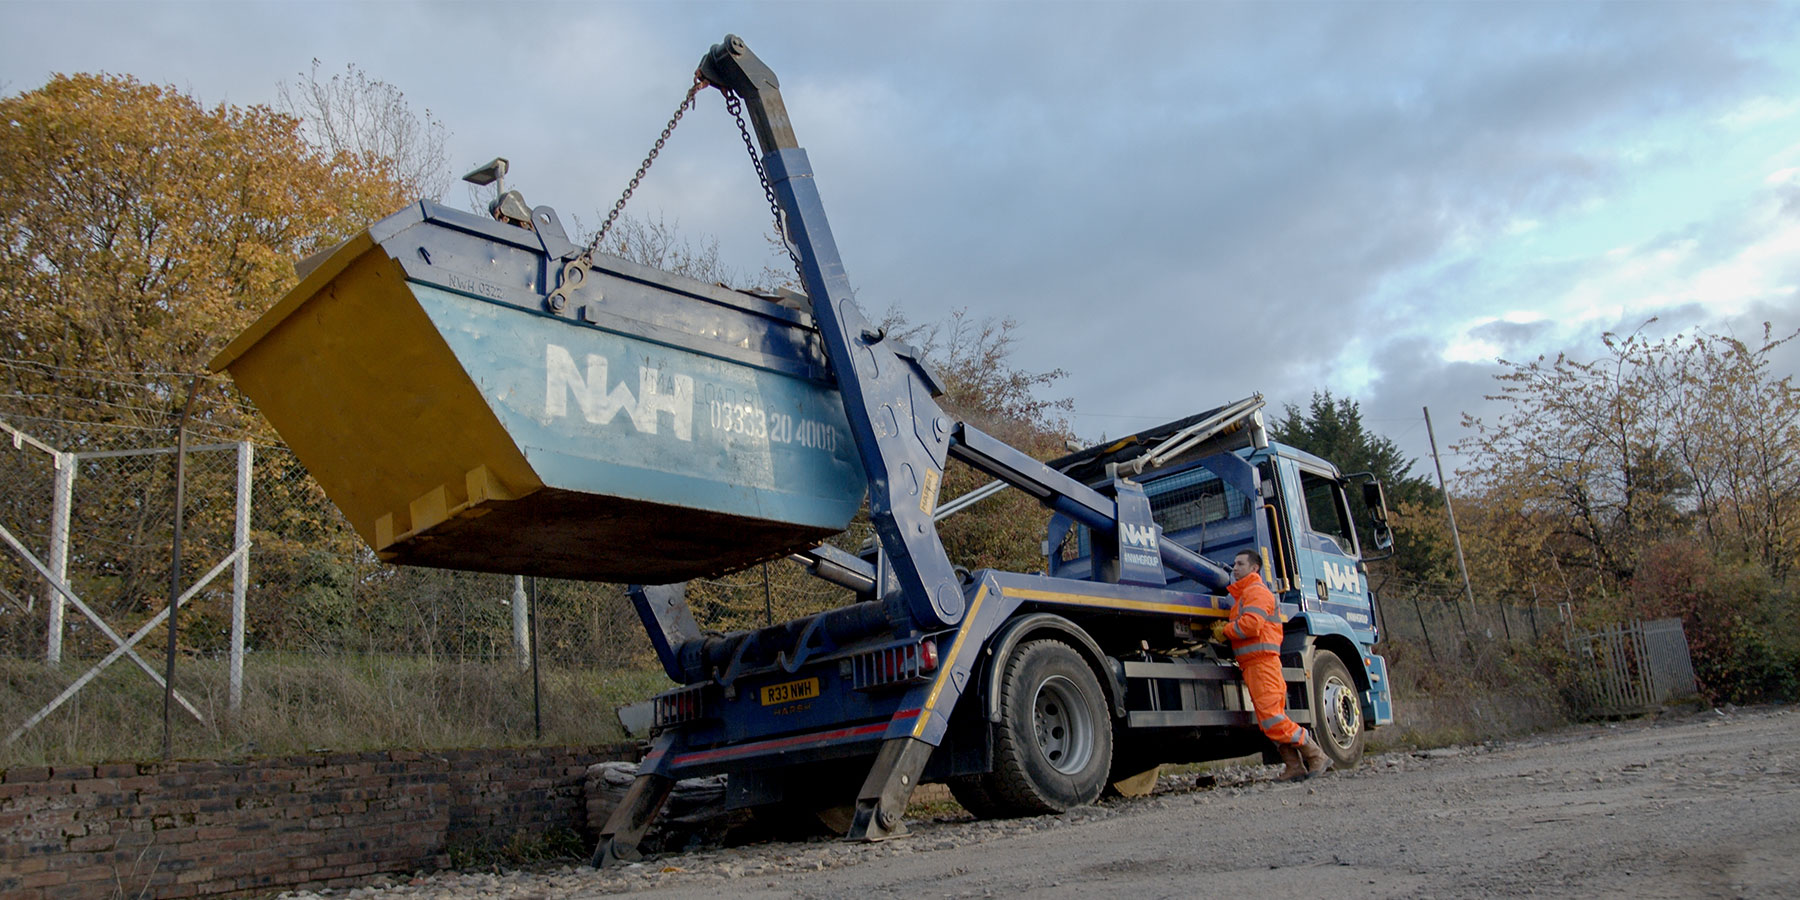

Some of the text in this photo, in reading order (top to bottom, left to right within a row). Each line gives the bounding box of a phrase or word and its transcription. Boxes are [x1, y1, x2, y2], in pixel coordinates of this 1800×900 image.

[448, 273, 475, 293] NWH
[545, 343, 694, 442] NWH
[710, 399, 837, 452] 03333 20 4000
[1119, 521, 1157, 548] NWH
[1322, 560, 1361, 595] NWH
[767, 680, 812, 702] R33 NWH
